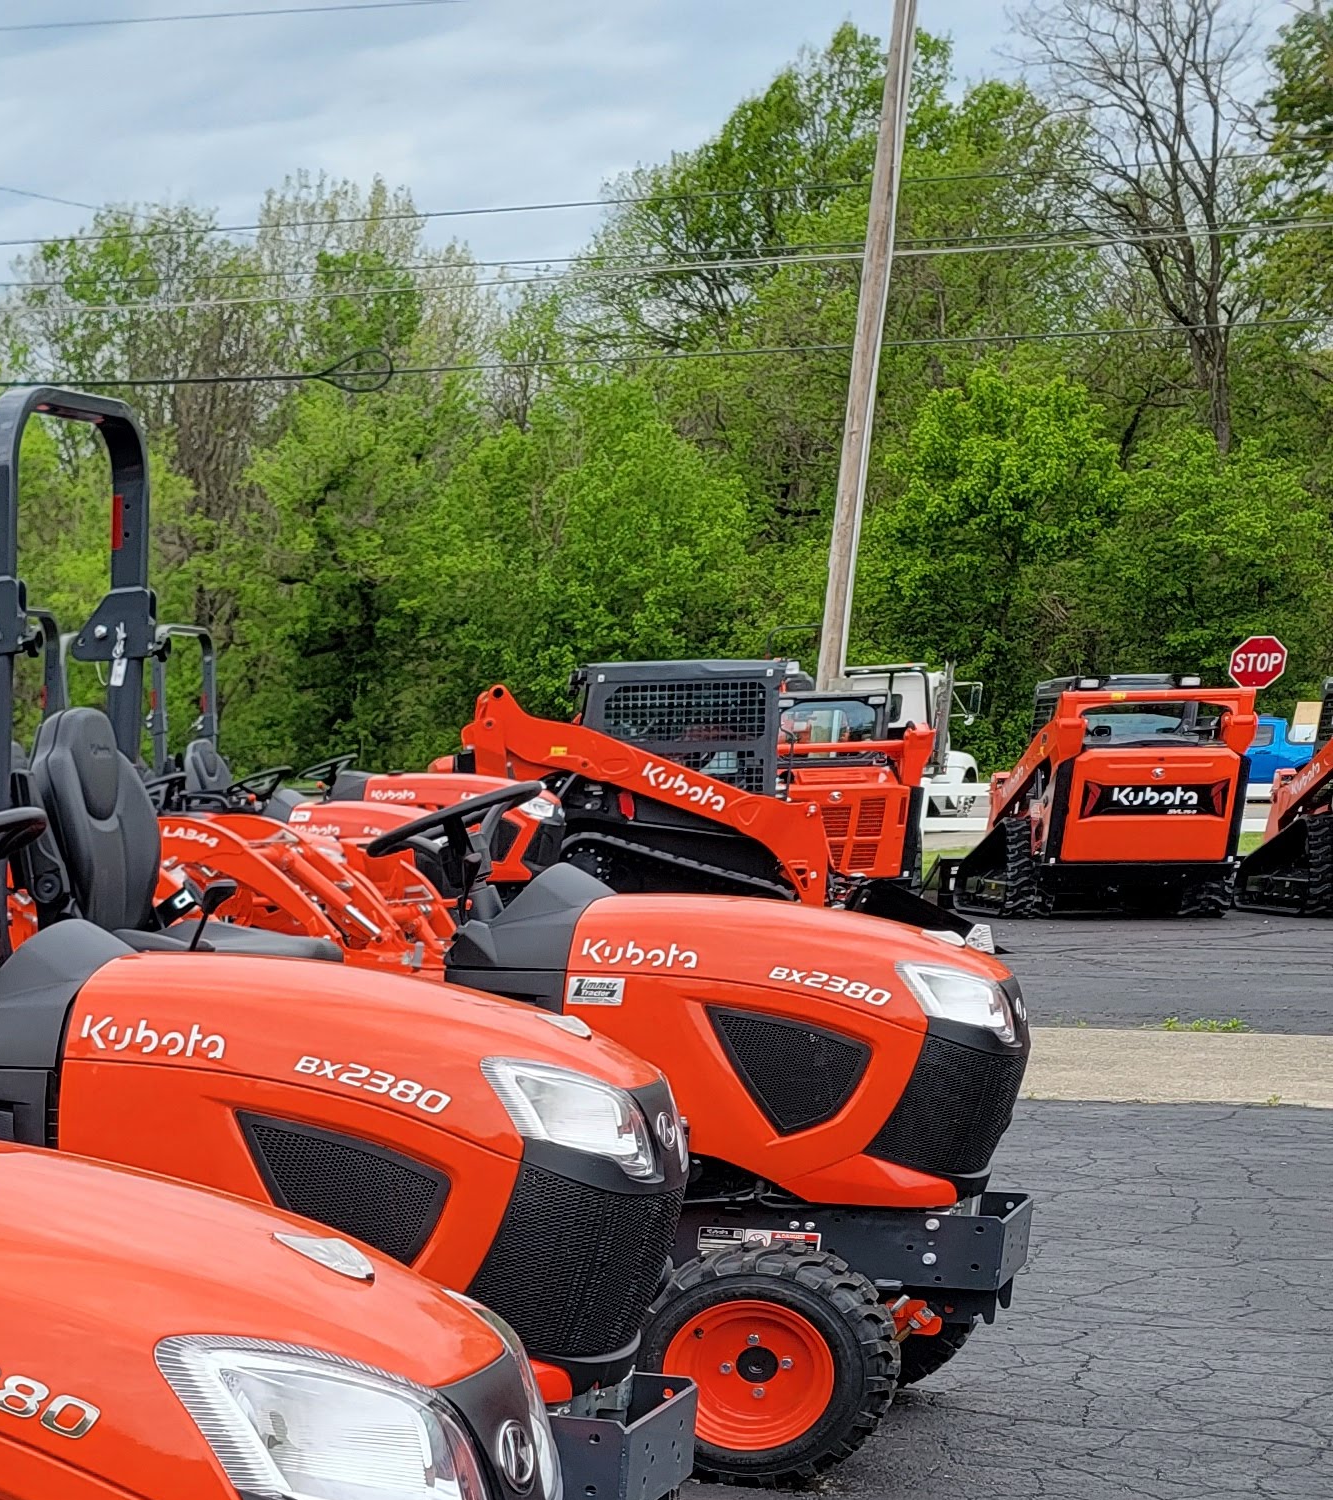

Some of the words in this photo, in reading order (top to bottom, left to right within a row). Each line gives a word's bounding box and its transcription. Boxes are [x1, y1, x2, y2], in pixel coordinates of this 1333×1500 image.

[1232, 652, 1283, 673] STOP
[371, 789, 416, 801] Kubota
[641, 761, 726, 812] Kubota
[1112, 786, 1199, 806] Kubota
[162, 825, 220, 848] LA344
[581, 938, 699, 970] Kubota
[574, 978, 618, 997] Zimmer
[769, 965, 892, 1007] BX2380
[80, 1014, 226, 1059] Kubota
[293, 1055, 452, 1115] BX2380
